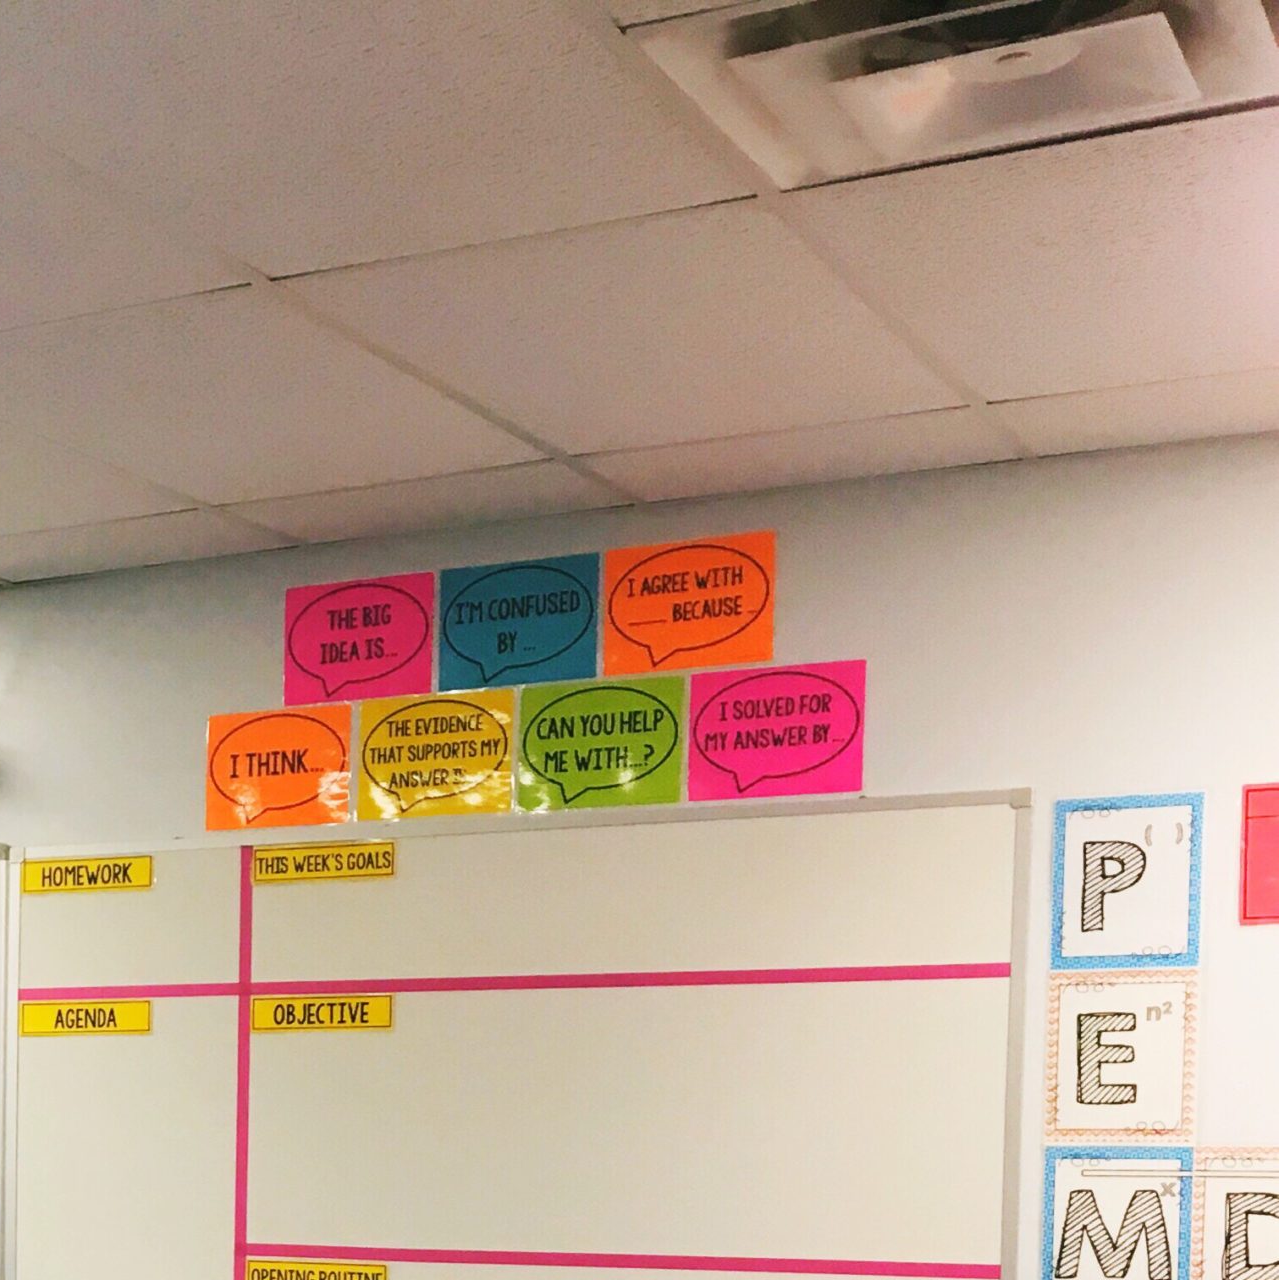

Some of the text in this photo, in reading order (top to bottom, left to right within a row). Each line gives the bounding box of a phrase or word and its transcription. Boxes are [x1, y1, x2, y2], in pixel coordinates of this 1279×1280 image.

[628, 565, 743, 598] I AGREE WITH
[327, 604, 391, 631] THE BIG
[455, 590, 581, 625] I'M CONFUSED
[672, 596, 743, 622] BECAUSE
[320, 641, 360, 665] IDEA
[497, 631, 518, 654] BY
[719, 693, 832, 721] I SOLVED FOR
[386, 713, 484, 738] THE EVIDENCE
[536, 708, 665, 740] CAN YOU HELP
[369, 738, 501, 764] THAT SUPPORTS MY
[703, 731, 728, 753] MY
[733, 727, 807, 750] ANSWER
[229, 754, 238, 778] I
[544, 750, 568, 774] ME
[389, 770, 448, 789] ANSWER
[41, 863, 133, 888] HOMEWORK
[255, 850, 392, 876] THIS WEEK'S GOALS
[1081, 840, 1147, 933] P
[54, 1008, 117, 1029] AGENDA
[273, 1002, 369, 1025] OBJECTIVE
[1076, 1011, 1138, 1105] E
